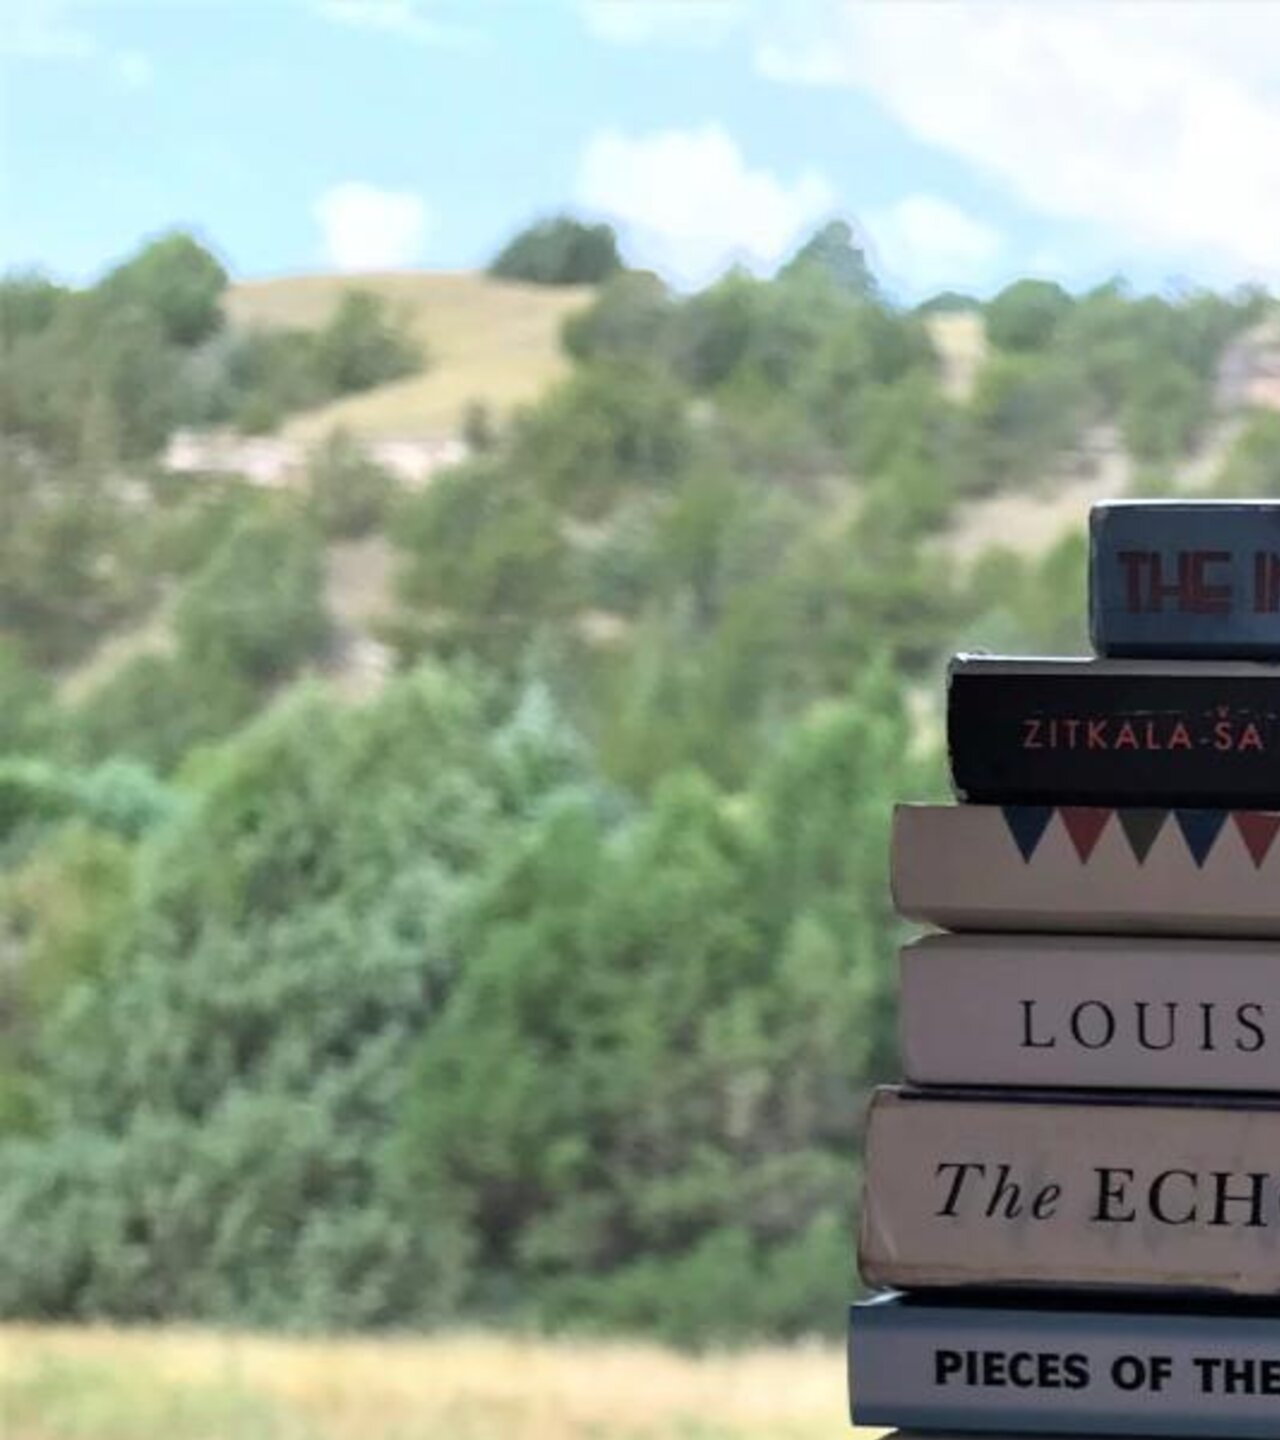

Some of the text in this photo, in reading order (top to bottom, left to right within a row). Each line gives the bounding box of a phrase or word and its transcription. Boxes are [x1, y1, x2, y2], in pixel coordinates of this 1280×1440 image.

[1118, 549, 1233, 615] THE
[934, 1163, 1062, 1221] The
[933, 1350, 1089, 1389] PIECES
[1112, 1355, 1172, 1393] OF
